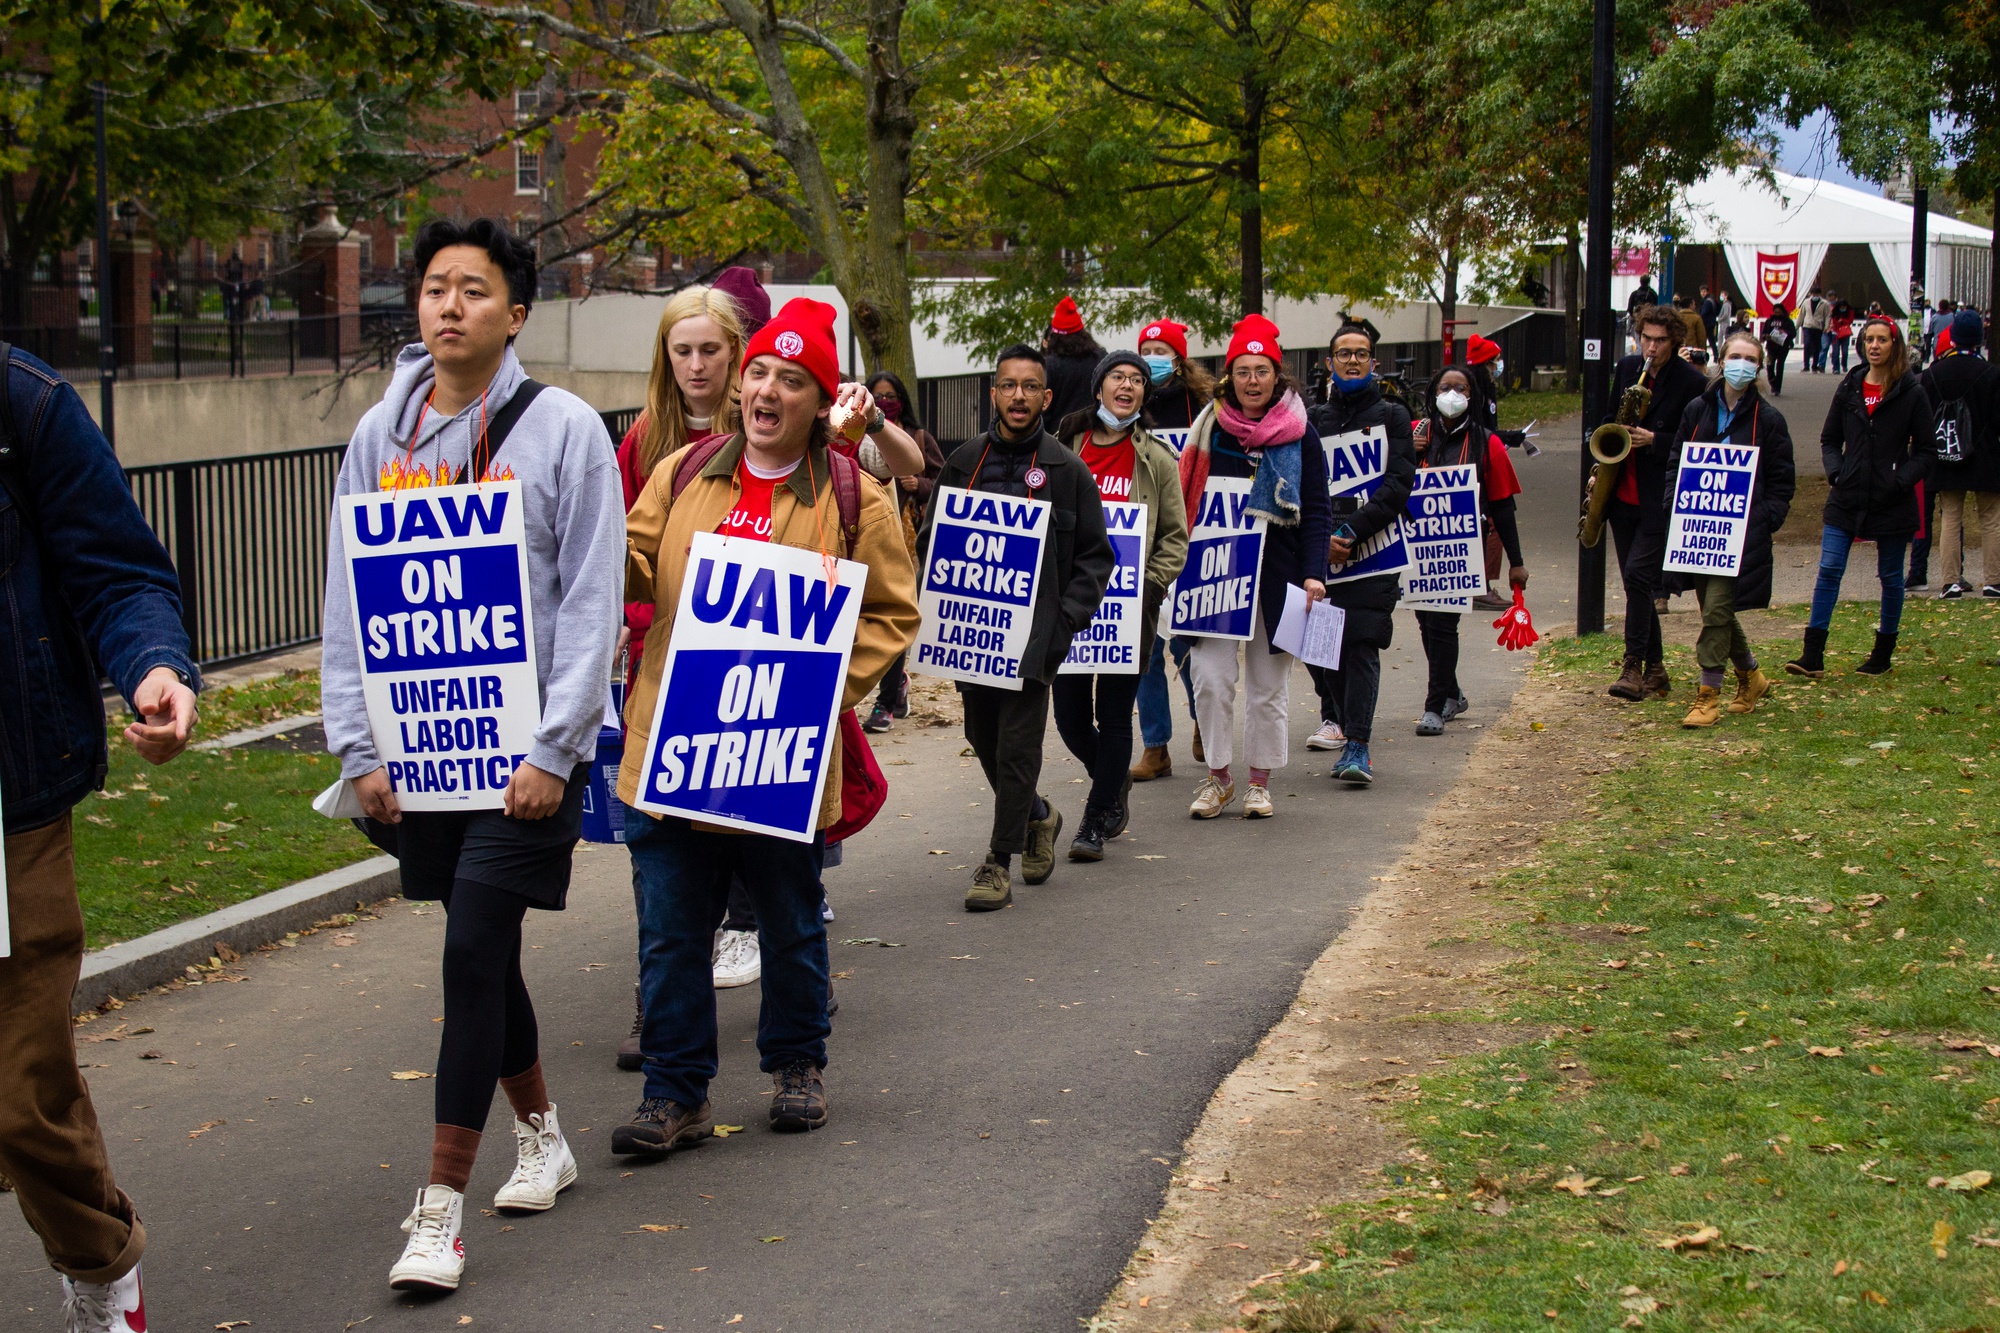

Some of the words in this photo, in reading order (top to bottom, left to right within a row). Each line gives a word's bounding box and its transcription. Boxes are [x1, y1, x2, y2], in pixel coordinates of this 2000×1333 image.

[1323, 438, 1381, 482] AW
[1687, 446, 1754, 467] UAW
[1700, 471, 1728, 491] ON
[945, 493, 1043, 530] UAW
[1423, 494, 1452, 515] ON
[1678, 490, 1746, 513] STRIKE
[354, 491, 509, 547] UAW
[1405, 514, 1475, 538] STRIKE
[1682, 518, 1733, 535] UNFAIR
[965, 532, 1006, 563] ON
[1415, 542, 1468, 560] UNFAIR
[1682, 535, 1727, 551] LABOR
[1200, 542, 1232, 581] ON
[1419, 559, 1467, 577] LABOR
[1669, 550, 1736, 568] PRACTICE
[401, 555, 463, 604] ON
[931, 557, 1031, 597] STRIKE
[1409, 574, 1481, 593] PRACTICE
[691, 557, 851, 646] UAW
[937, 599, 1013, 630] UNFAIR
[1175, 575, 1252, 624] STRIKE
[368, 604, 519, 660] STRIKE
[937, 622, 1005, 652] LABOR
[918, 643, 1019, 679] PRACTICE
[1061, 645, 1133, 664] ACTICE
[389, 675, 504, 716] UNFAIR
[718, 662, 785, 724] ON
[399, 716, 500, 754] LABOR
[656, 725, 820, 794] STRIKE
